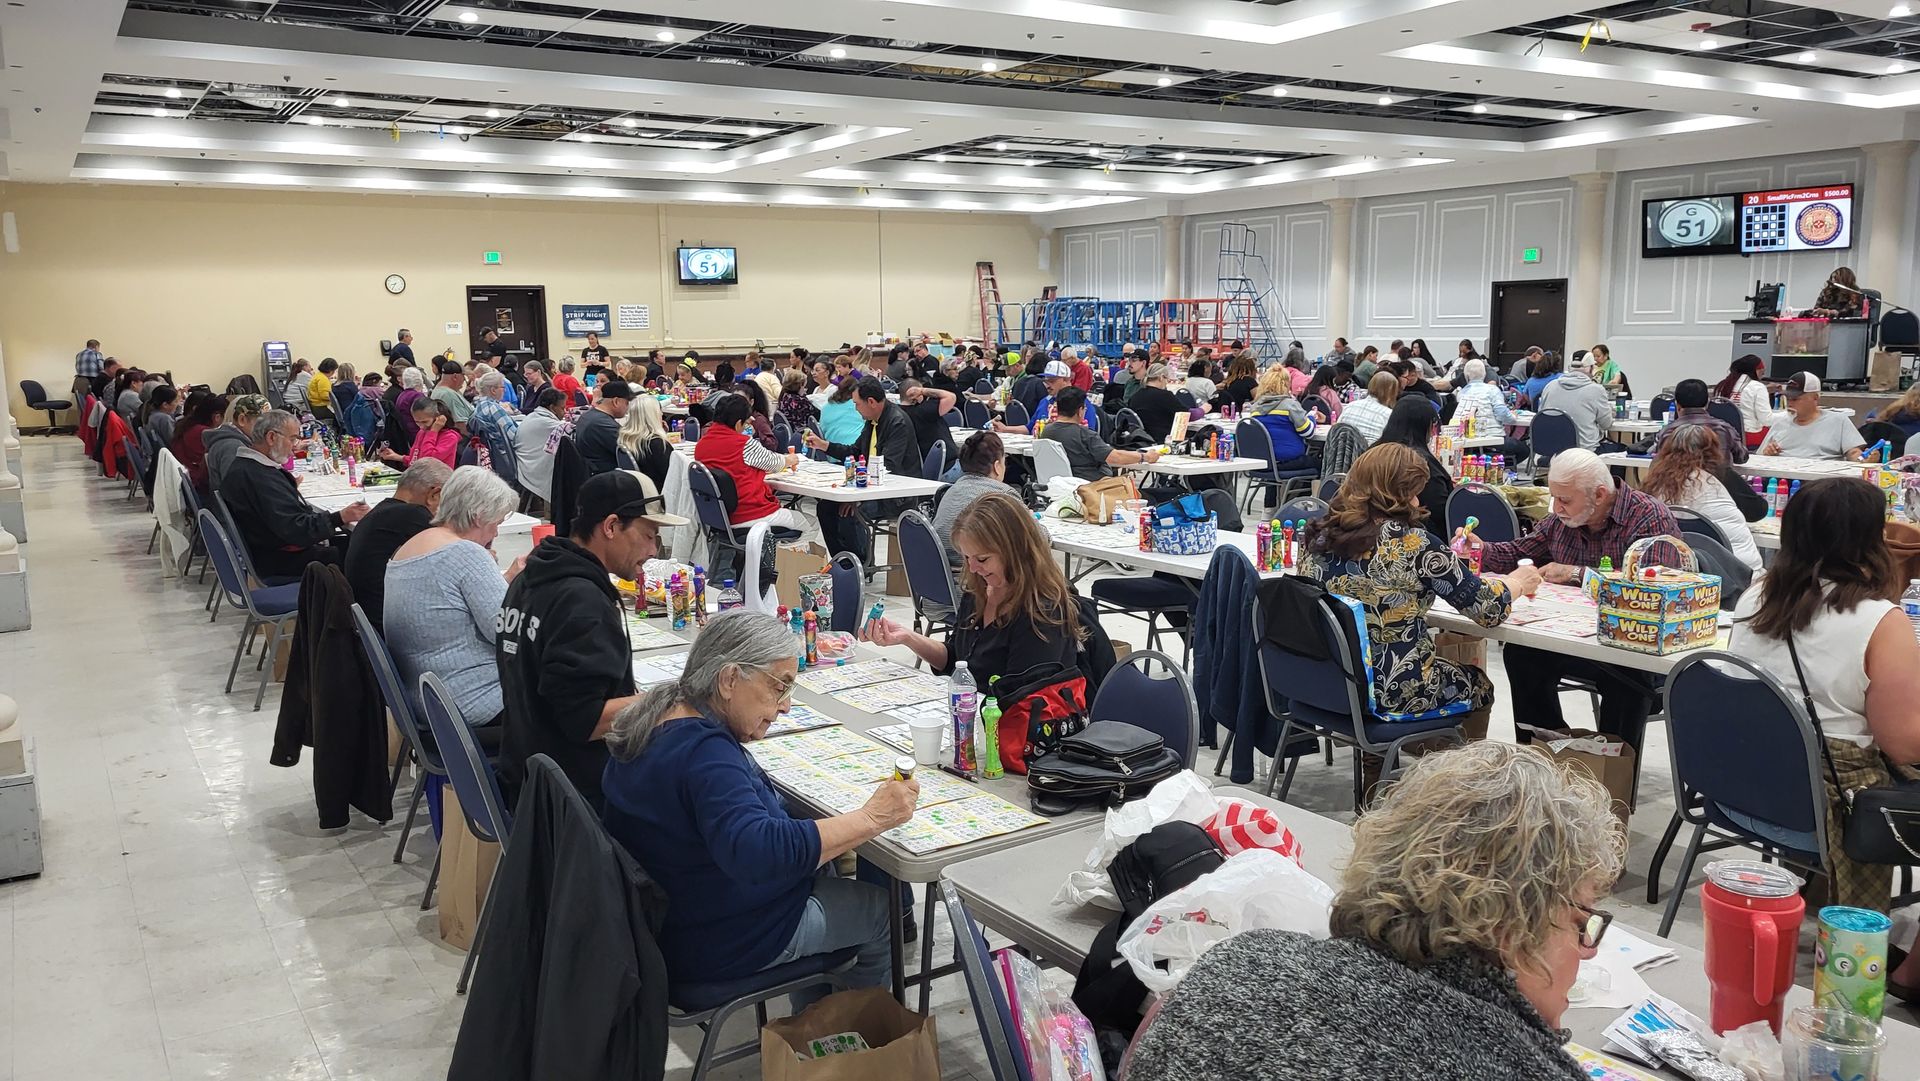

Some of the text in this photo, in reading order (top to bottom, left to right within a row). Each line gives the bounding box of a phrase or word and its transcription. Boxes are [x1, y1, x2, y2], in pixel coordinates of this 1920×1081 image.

[1748, 195, 1759, 205] 20
[1824, 189, 1849, 198] $500.00
[1686, 208, 1697, 216] G
[1676, 219, 1706, 237] 51
[700, 261, 718, 273] 51
[1622, 587, 1662, 602] WILD
[1694, 585, 1719, 601] WILD
[1629, 600, 1660, 610] ONE
[1699, 594, 1717, 607] ONE
[1619, 618, 1659, 634] WILD
[1692, 617, 1716, 633] WILD
[1696, 626, 1714, 638] ONE
[1626, 632, 1657, 642] ONE
